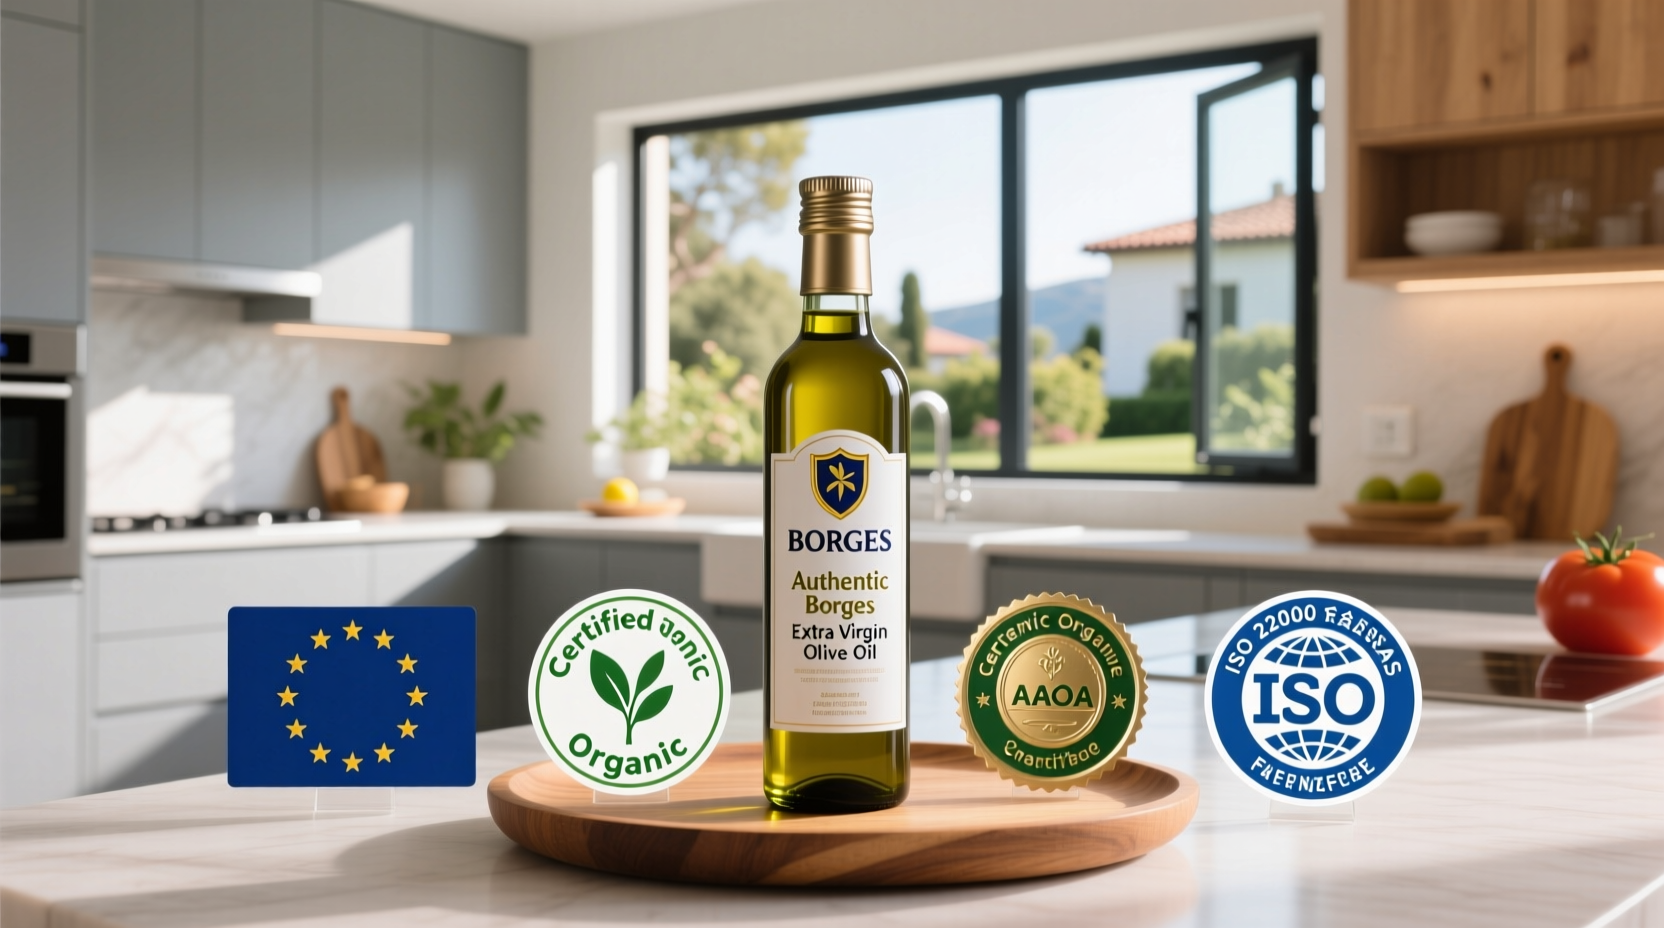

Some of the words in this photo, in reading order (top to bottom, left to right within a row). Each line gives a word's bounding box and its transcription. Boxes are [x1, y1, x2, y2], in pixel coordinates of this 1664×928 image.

[788, 529, 892, 552] BORGES
[791, 570, 889, 591] Authentic
[805, 595, 875, 619] Borges
[549, 608, 655, 678] Certified
[791, 623, 834, 640] Extra
[839, 623, 888, 643] Virgin
[1225, 638, 1253, 674] ISO
[1253, 604, 1316, 639] 22000
[804, 644, 848, 660] Olive
[853, 644, 877, 660] Oil
[1011, 684, 1094, 708] AAOA
[1253, 672, 1376, 726] ISO
[569, 733, 688, 779] Organic
